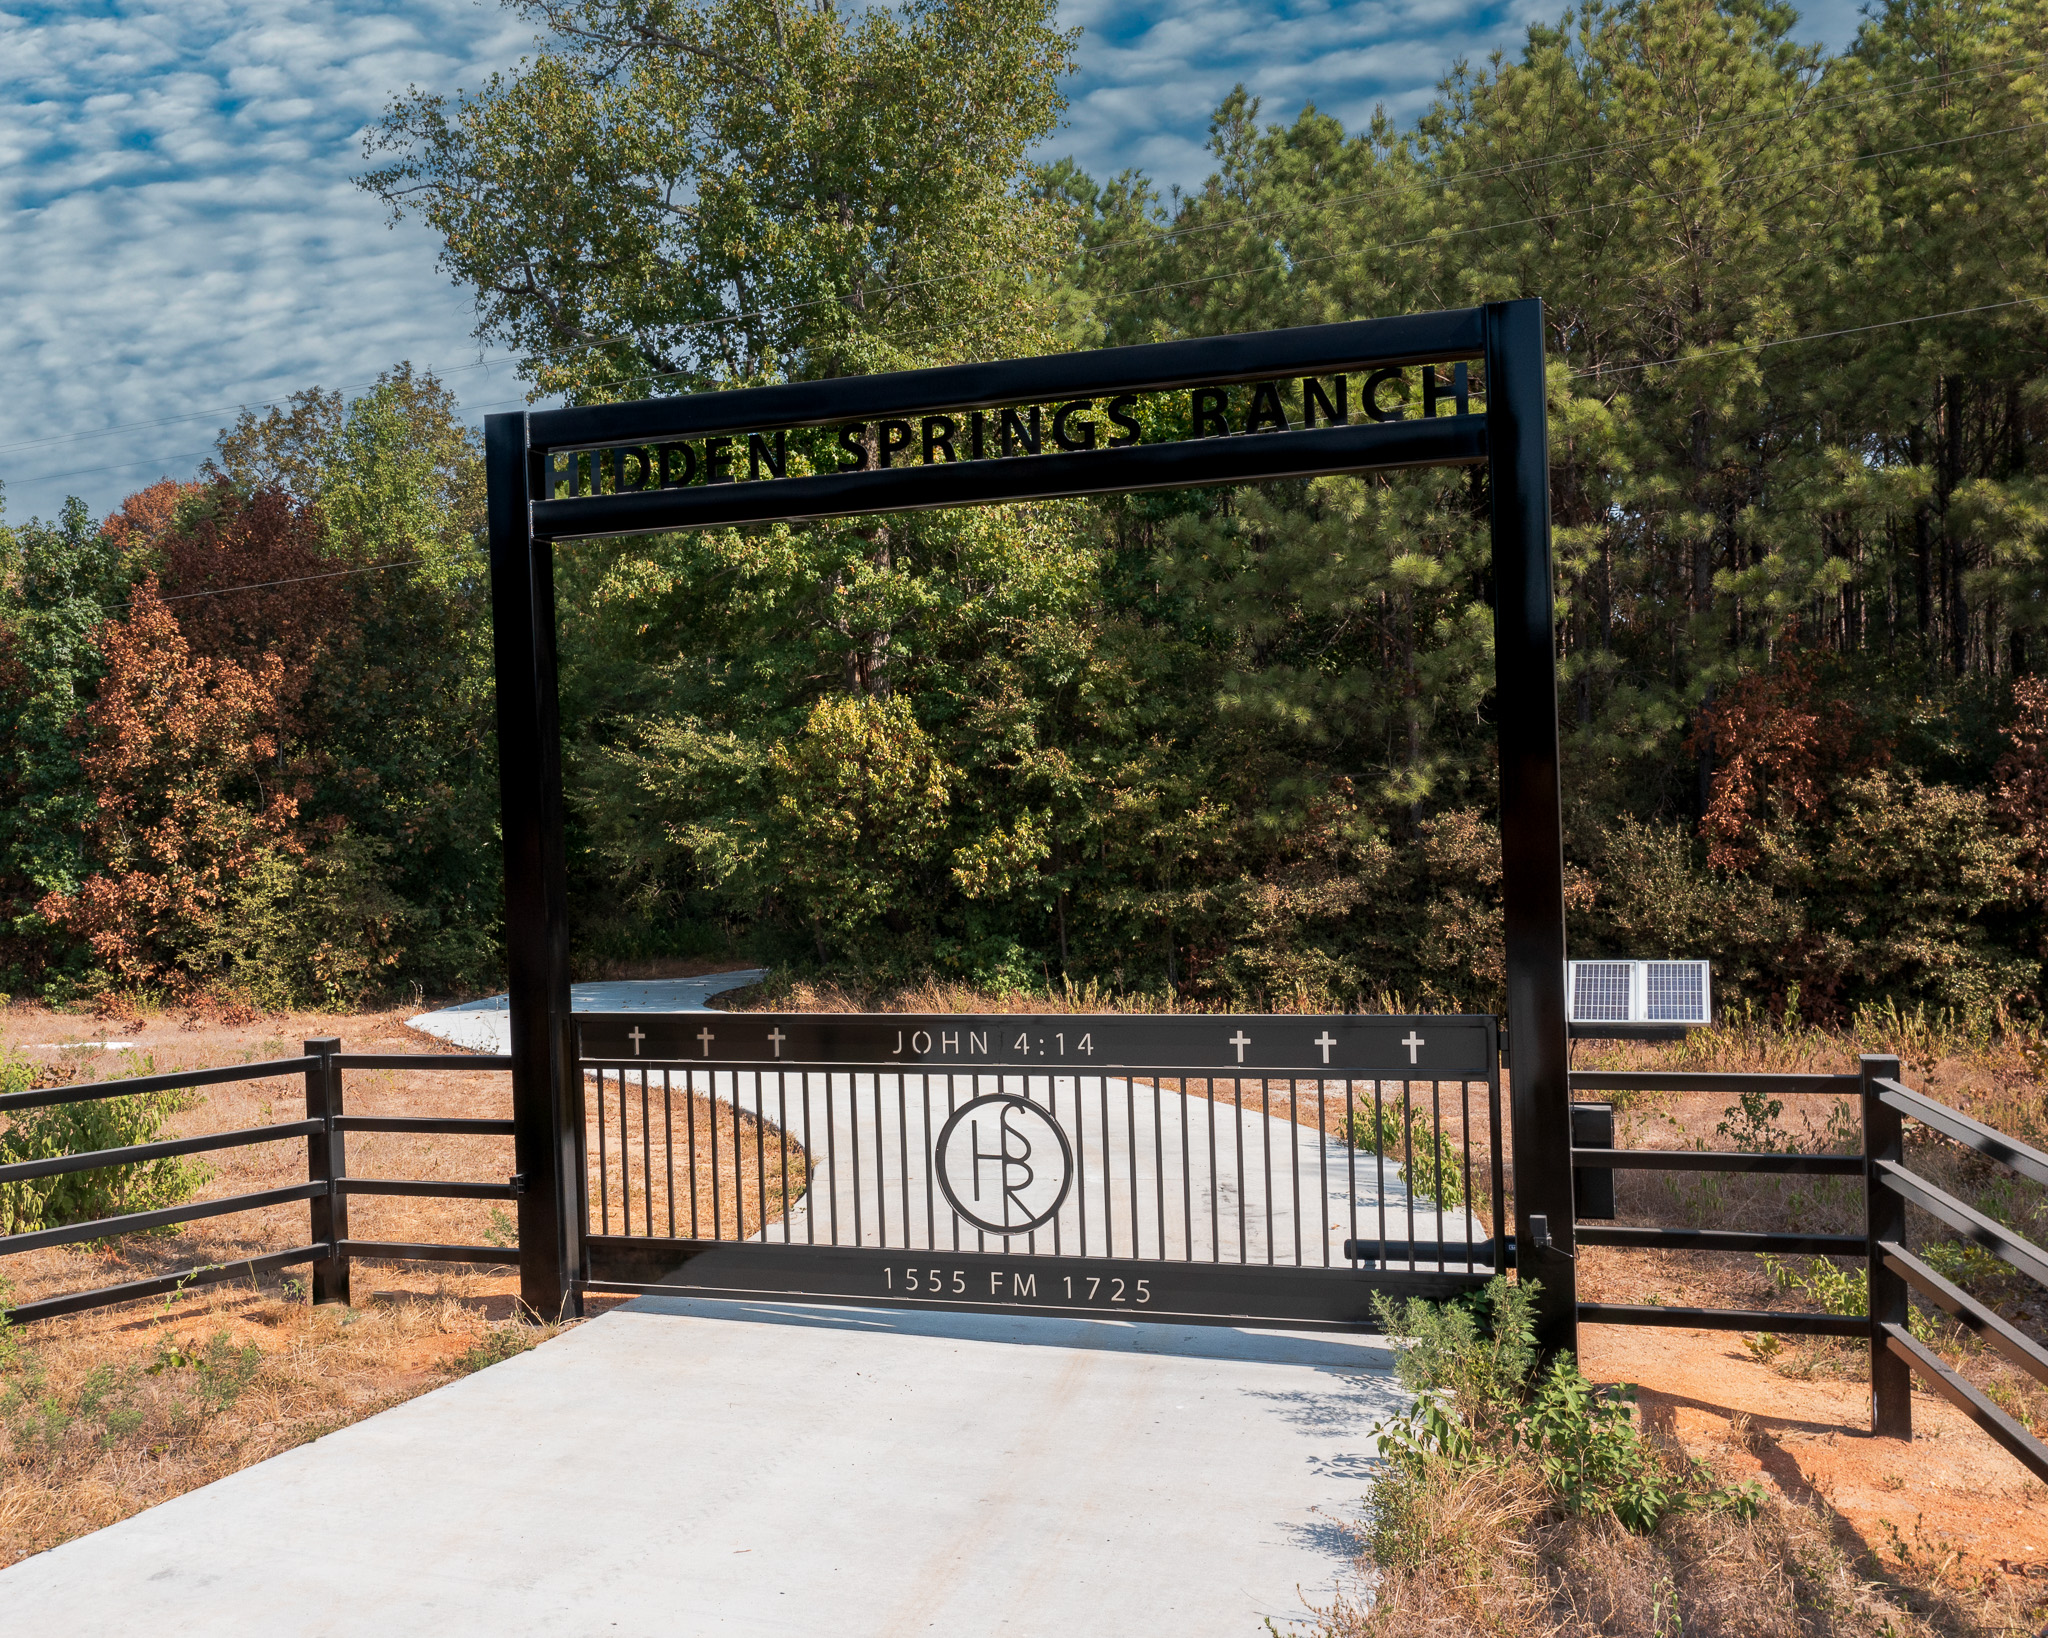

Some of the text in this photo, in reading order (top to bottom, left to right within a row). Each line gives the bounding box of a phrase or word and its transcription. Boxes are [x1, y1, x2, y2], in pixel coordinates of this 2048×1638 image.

[544, 362, 1469, 499] HIDDEN SPRINGS RANCH
[893, 1031, 1094, 1056] JOHN 4:14
[883, 1266, 1150, 1303] 1555 FM 1725
